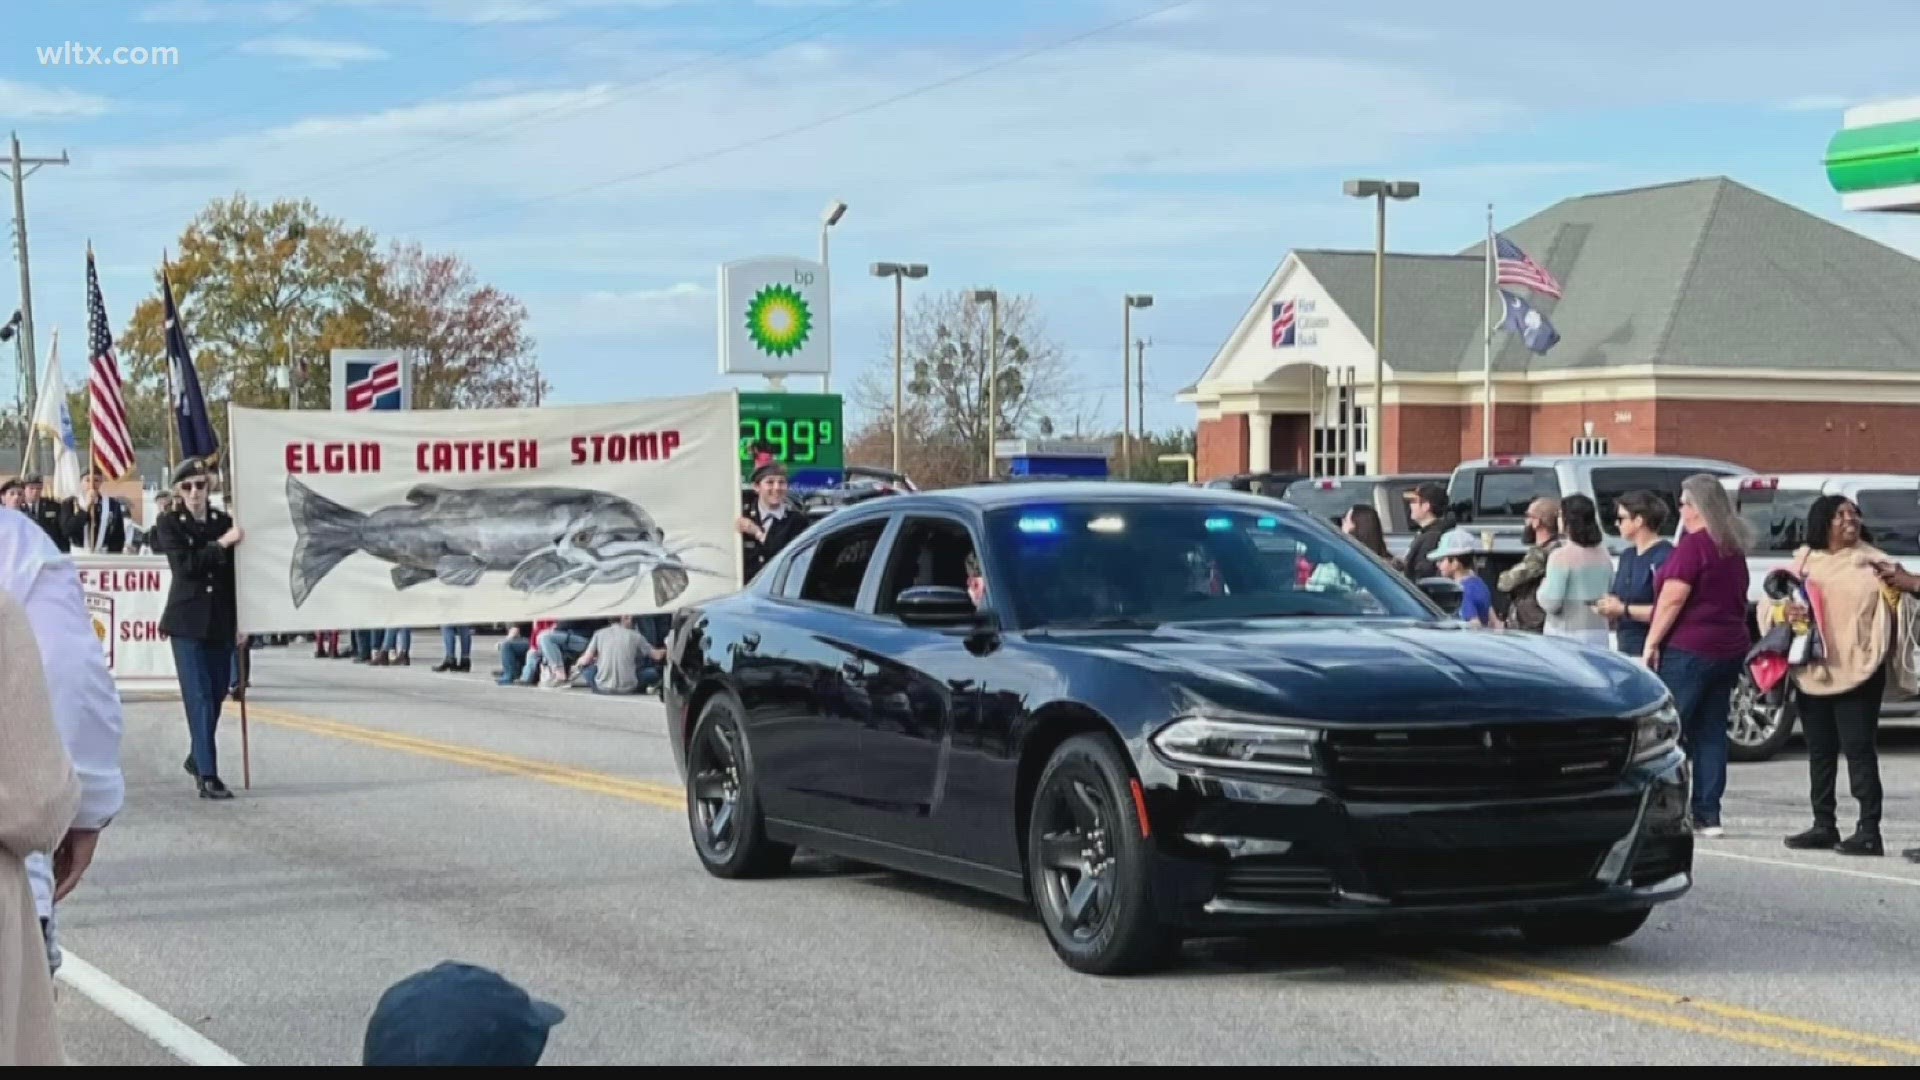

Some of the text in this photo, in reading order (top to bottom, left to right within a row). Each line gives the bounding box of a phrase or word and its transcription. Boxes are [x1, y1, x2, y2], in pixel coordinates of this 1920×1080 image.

[794, 268, 814, 285] bp
[285, 430, 680, 474] ELGIN CATFISH STOMP
